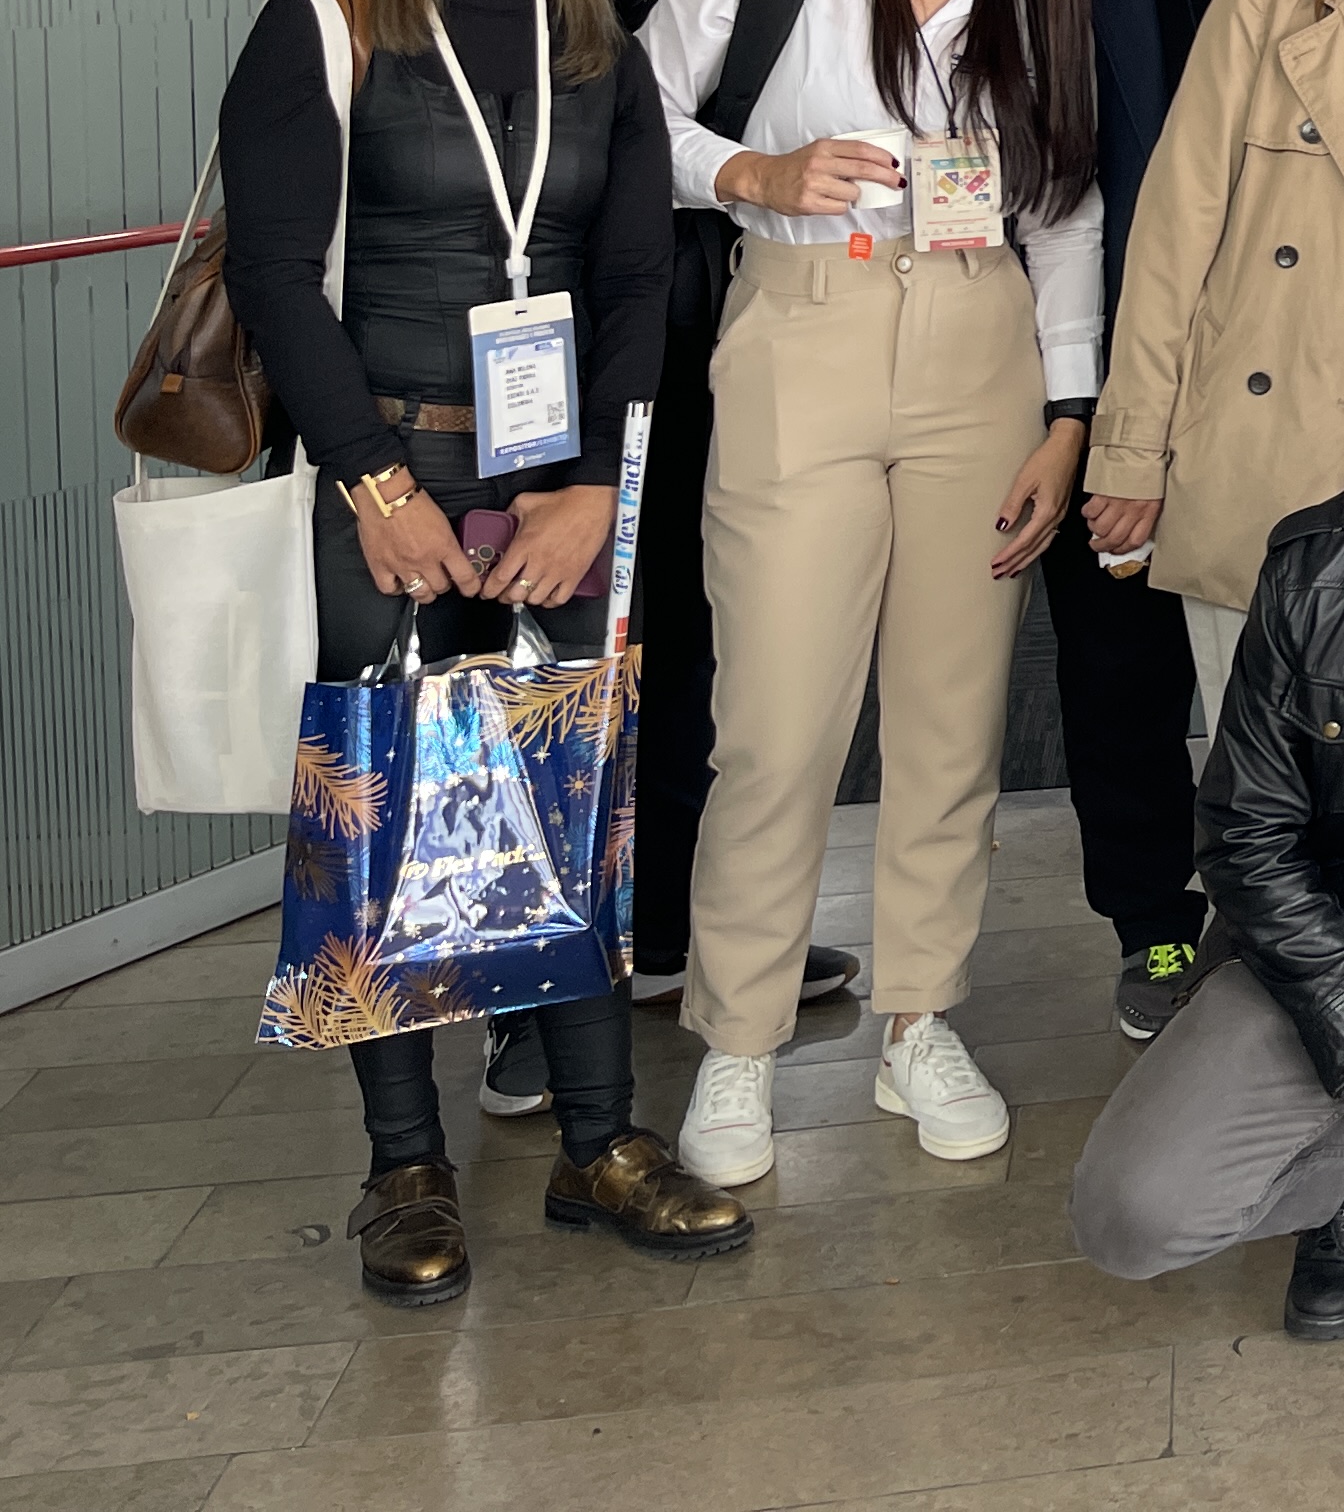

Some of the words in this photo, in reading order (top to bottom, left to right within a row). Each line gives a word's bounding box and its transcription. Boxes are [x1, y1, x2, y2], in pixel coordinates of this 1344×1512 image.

[619, 450, 642, 507] Pack
[615, 514, 637, 559] Flex
[430, 855, 475, 878] Flex
[477, 845, 528, 869] Pack
